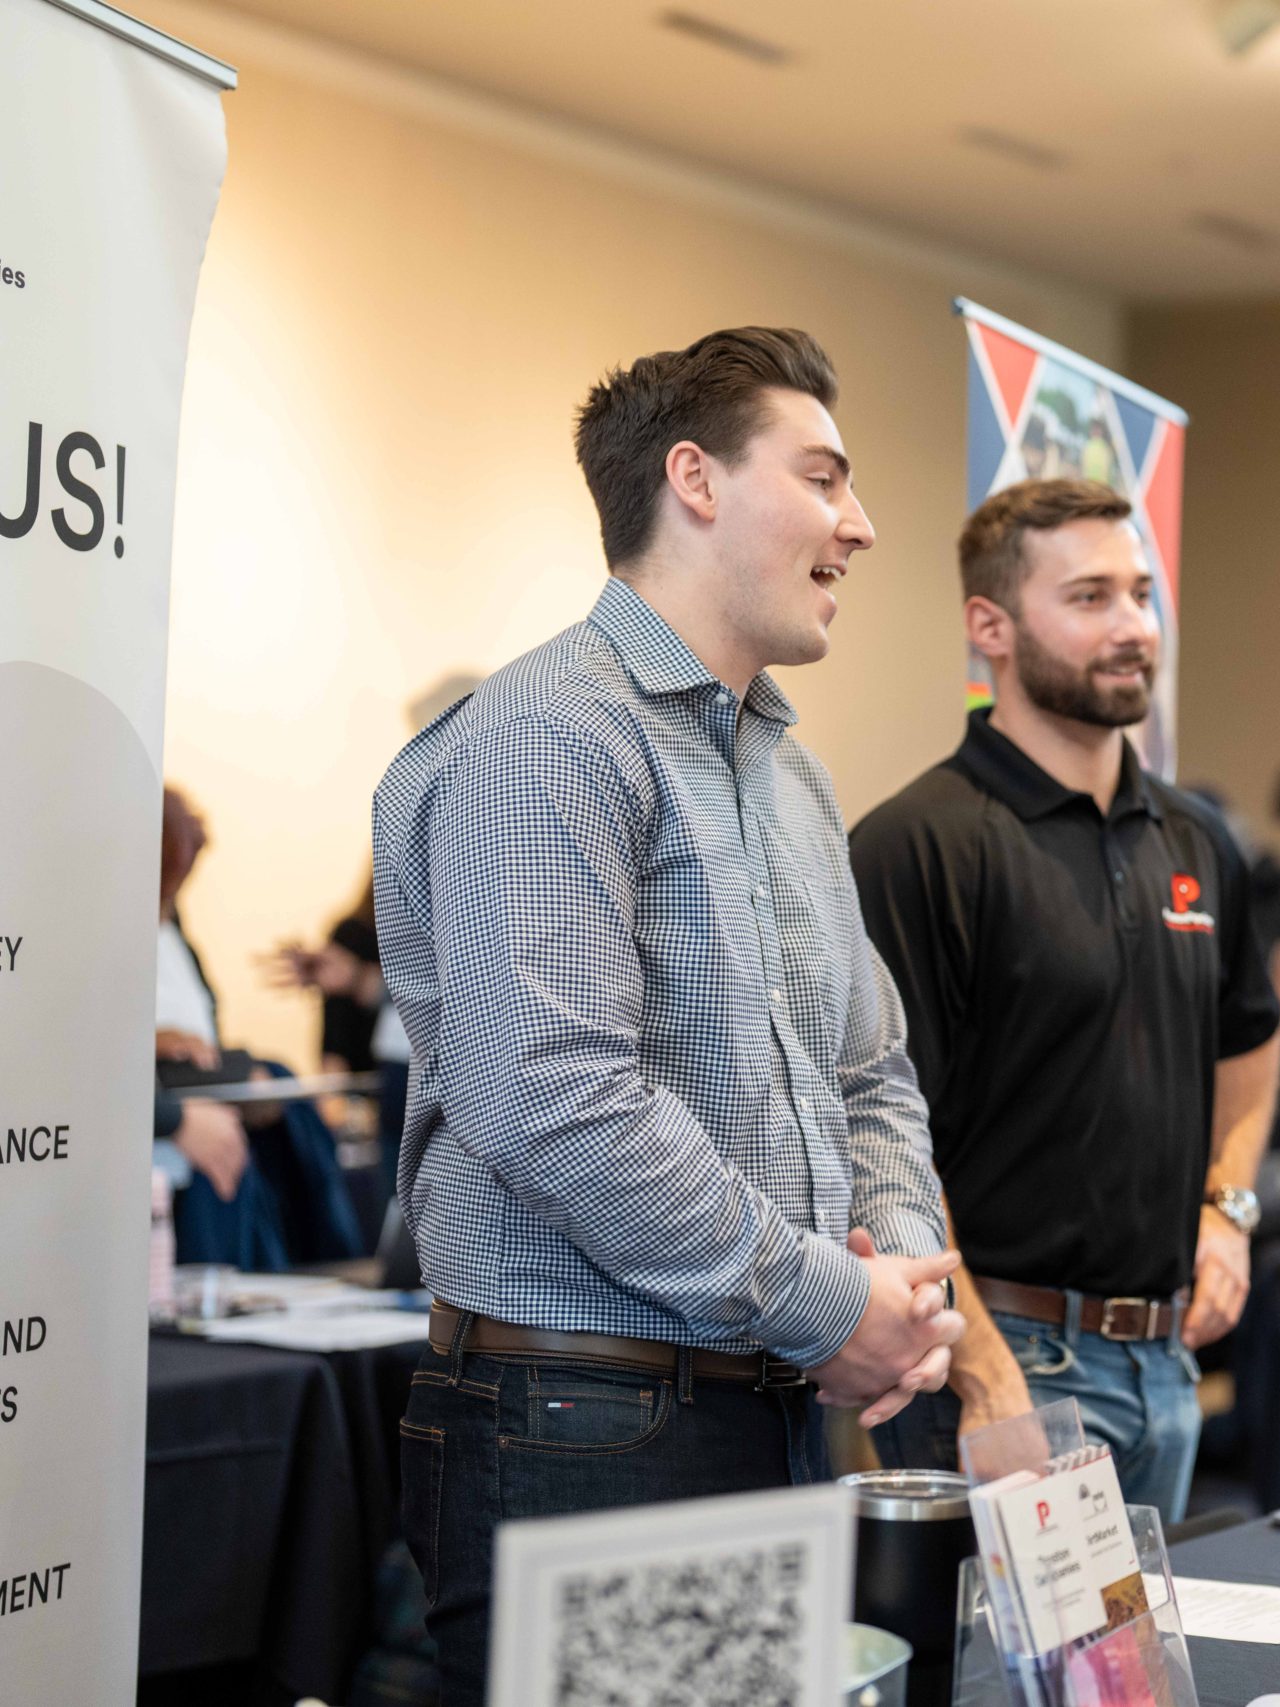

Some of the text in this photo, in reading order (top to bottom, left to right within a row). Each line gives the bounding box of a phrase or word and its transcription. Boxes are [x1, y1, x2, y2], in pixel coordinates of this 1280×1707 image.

[0, 259, 25, 289] es
[0, 937, 23, 971] Y
[0, 1125, 69, 1164] NCE
[0, 1386, 18, 1423] S
